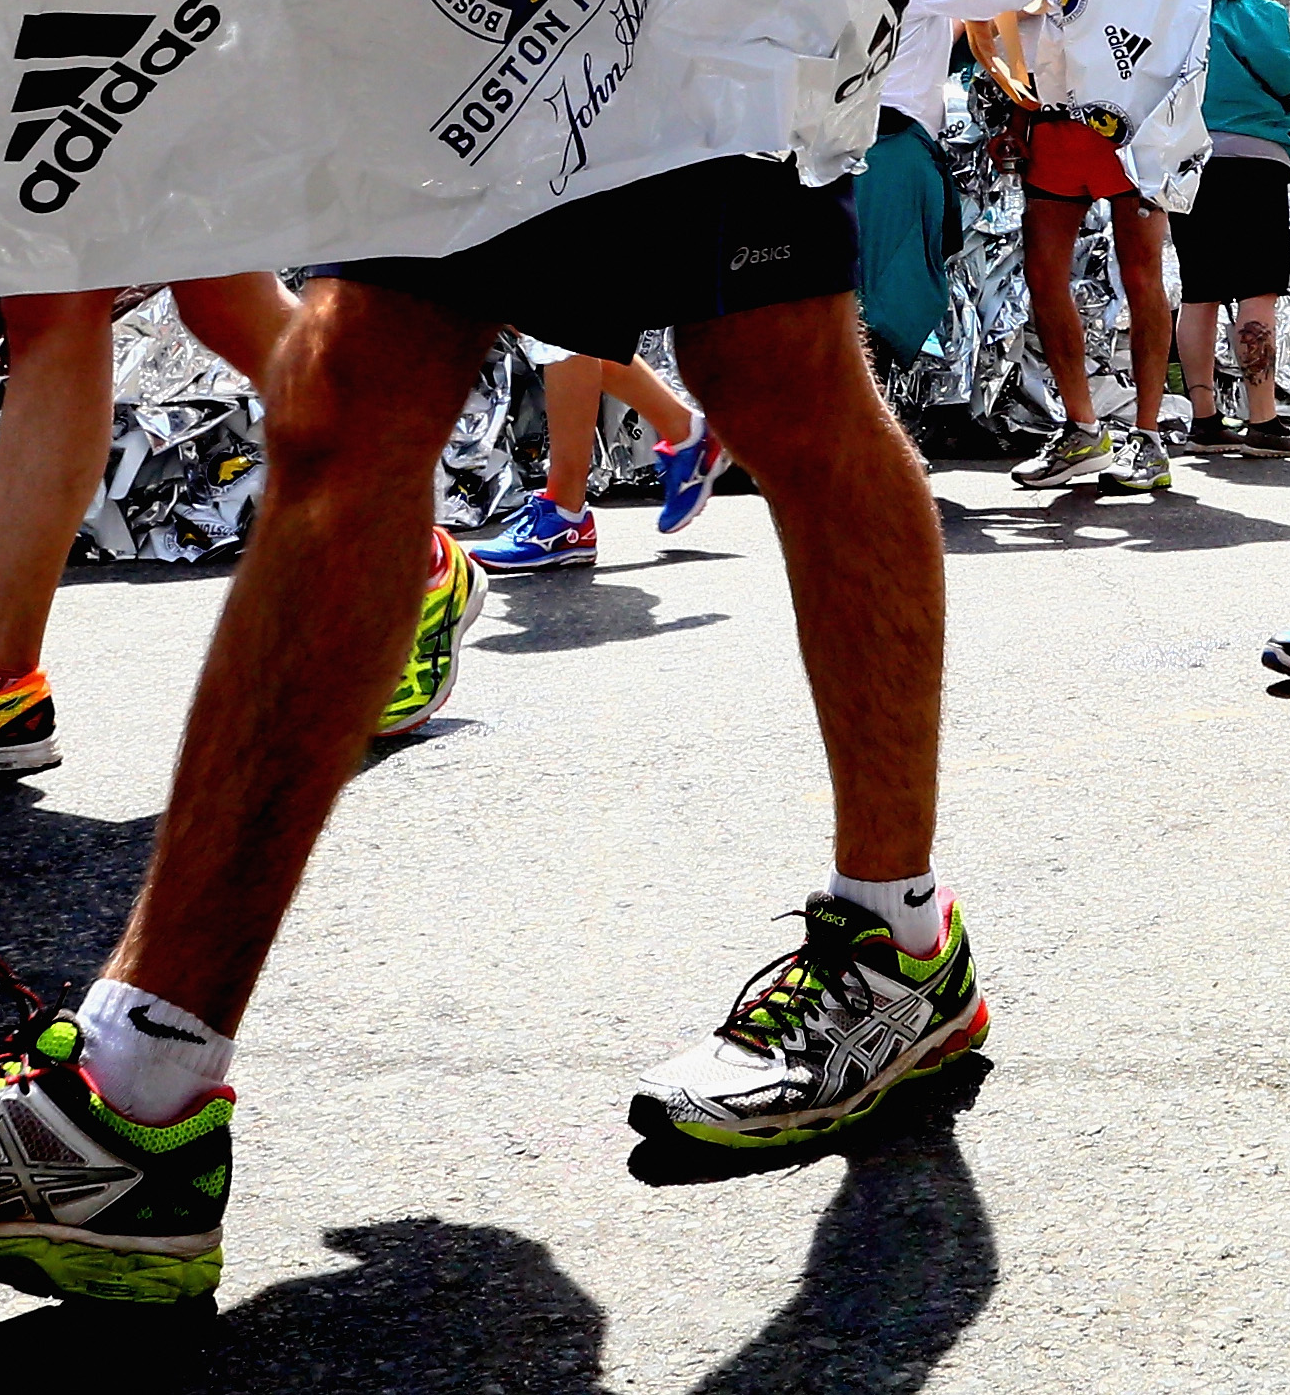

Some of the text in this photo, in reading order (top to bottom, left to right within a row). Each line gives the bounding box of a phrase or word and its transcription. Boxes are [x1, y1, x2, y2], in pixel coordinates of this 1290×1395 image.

[438, 9, 570, 158] BOSTON
[1104, 24, 1132, 81] adidas
[544, 53, 626, 196] John
